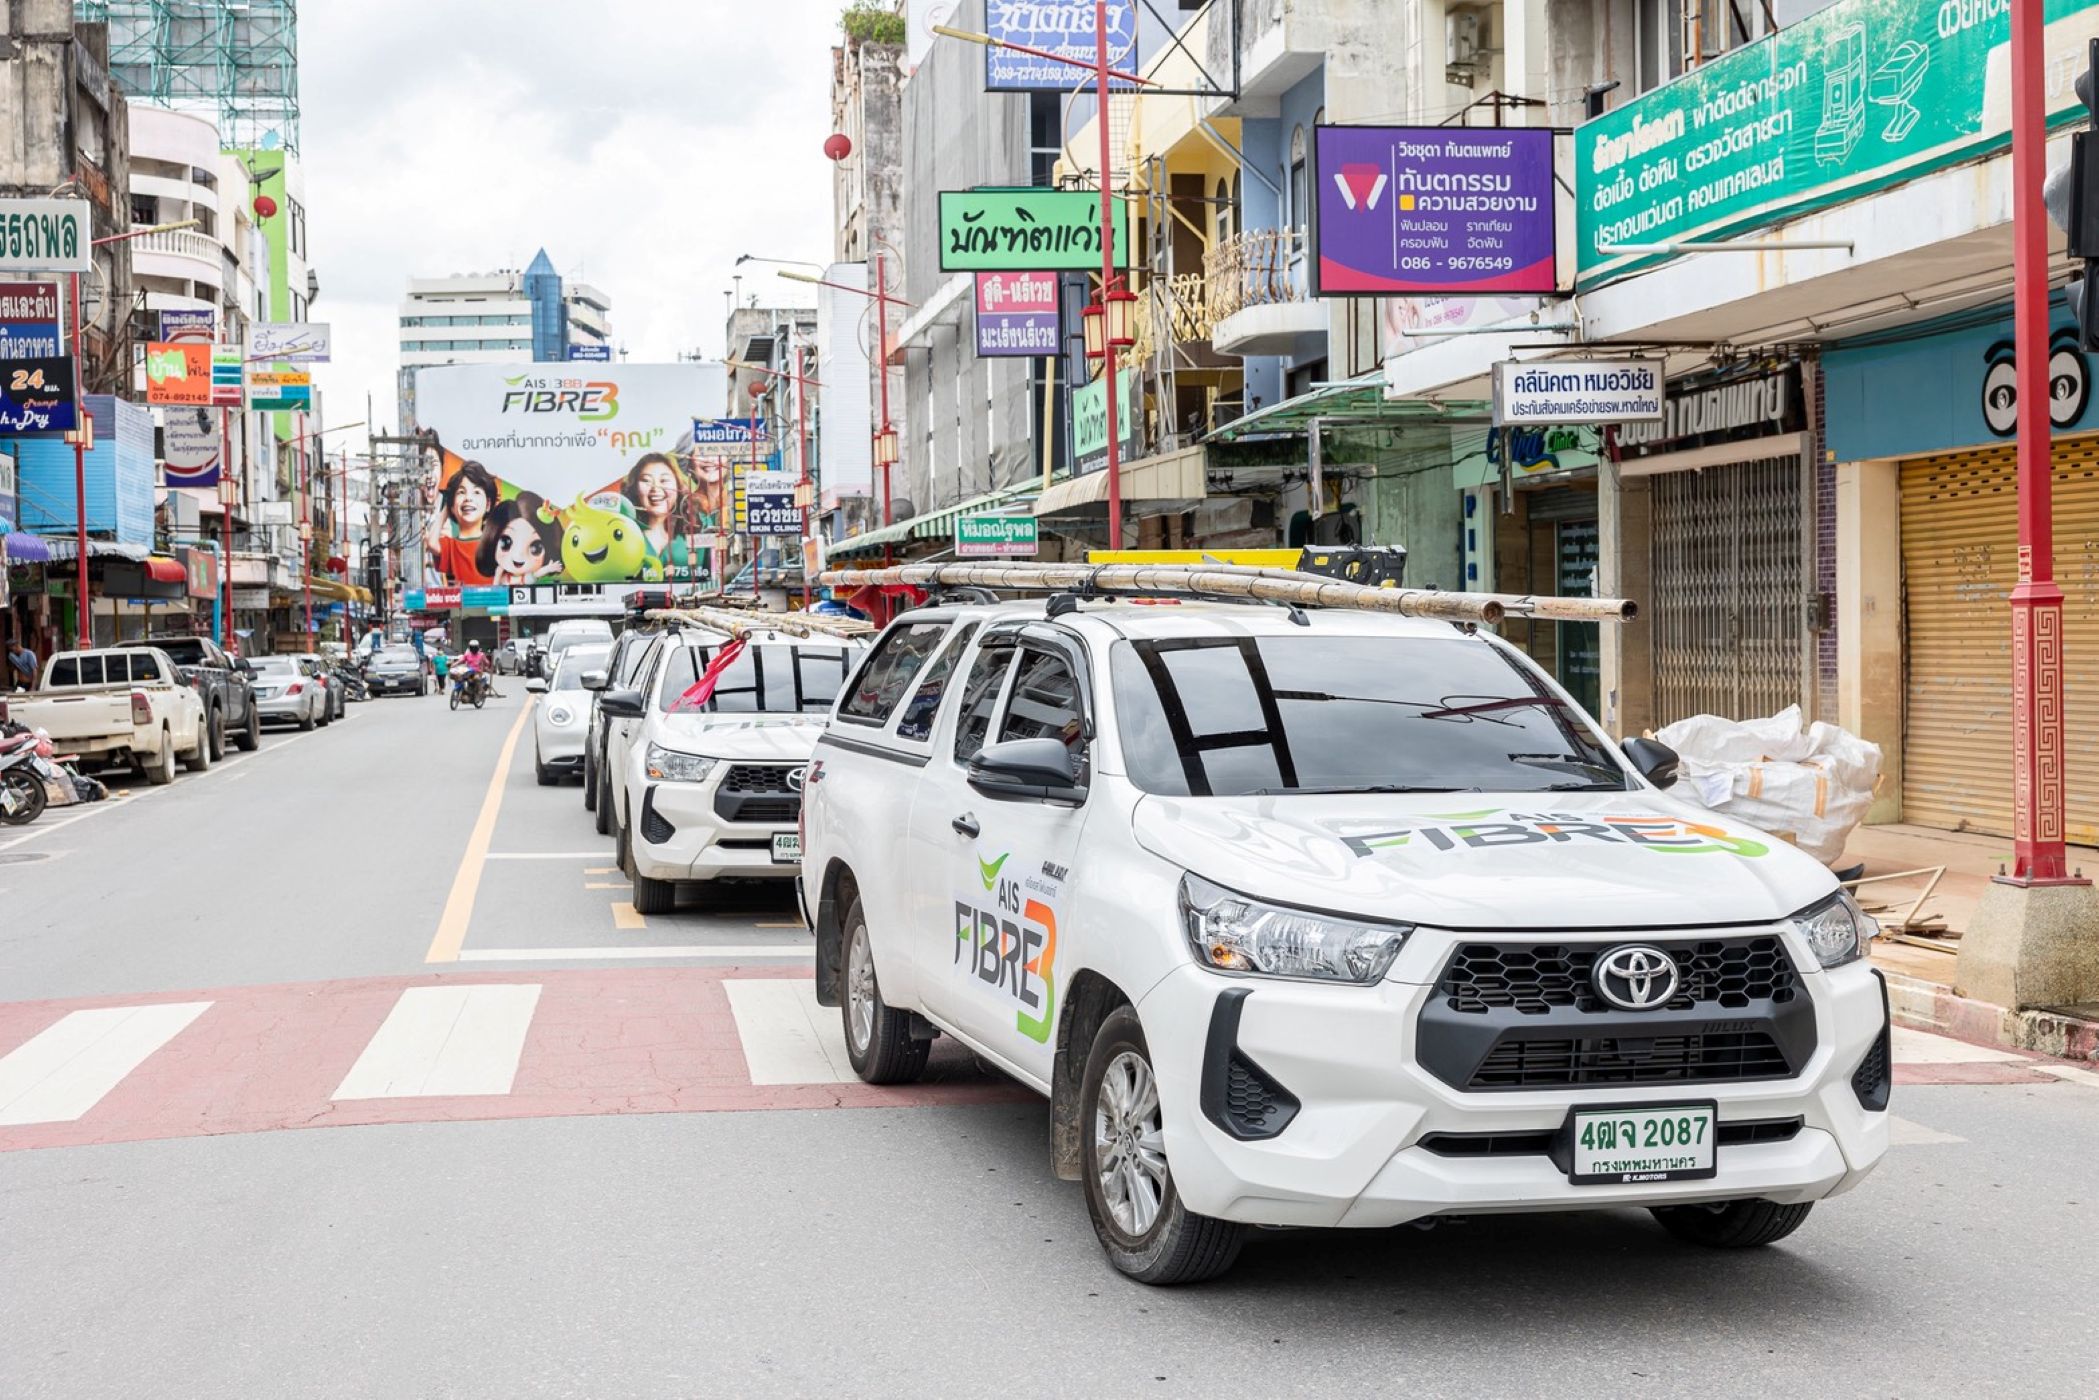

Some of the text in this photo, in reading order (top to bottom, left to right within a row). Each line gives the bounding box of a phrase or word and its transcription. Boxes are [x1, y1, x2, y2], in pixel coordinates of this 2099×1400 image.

[1399, 140, 1513, 163] วิชชุดา ทันตแพทย์
[1399, 167, 1512, 192] ทันตกรรม
[1593, 167, 1635, 212] ต้อเนื้อ
[1638, 155, 1679, 193] ต้อหิน
[1418, 195, 1537, 212] ความสวยงาม
[1400, 218, 1513, 233] ฟันปลอม รากเทียม
[1593, 198, 1684, 250] ประกอบแว่นตา
[1400, 235, 1504, 250] ครอบฟัน จัดฟัน
[1401, 256, 1431, 271] 086
[1447, 256, 1513, 271] 9676549
[10, 368, 45, 391] 24
[524, 379, 547, 389] AIS
[1513, 367, 1654, 394] คลีนิคตา หมอวิชัย
[750, 524, 803, 533] SKIN CLINIC
[662, 566, 689, 578] 175
[1510, 812, 1584, 823] AIS
[998, 877, 1020, 916] AIS
[1643, 1115, 1709, 1149] 2087
[1592, 1156, 1697, 1173] กรงเทพมหานคร
